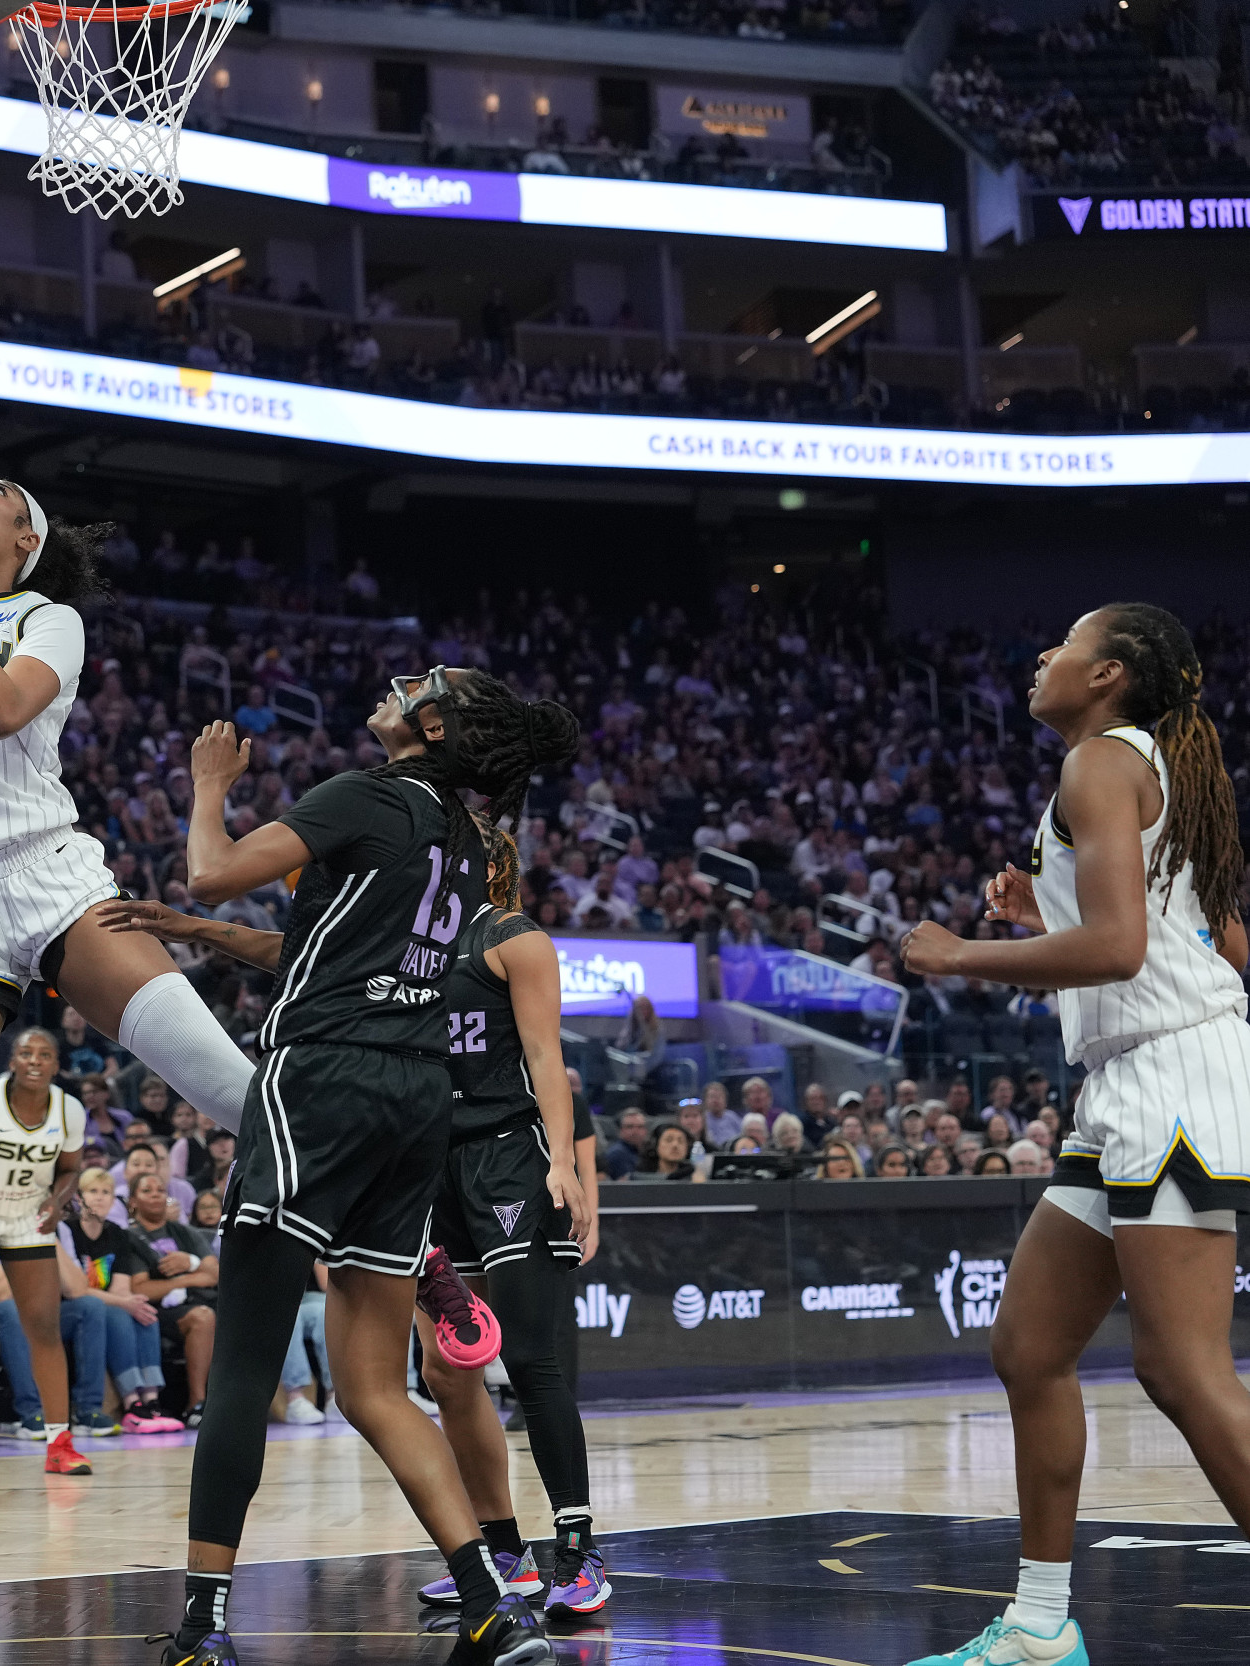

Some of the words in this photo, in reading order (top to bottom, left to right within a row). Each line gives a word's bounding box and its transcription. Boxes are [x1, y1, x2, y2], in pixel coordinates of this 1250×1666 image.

[367, 171, 472, 207] Rakuten
[1101, 200, 1185, 230] GOLDEN
[8, 362, 76, 391] YOUR
[83, 372, 197, 408] FAVORITE
[206, 390, 294, 421] STORES
[648, 434, 714, 457] CASH
[722, 437, 784, 460] BACK
[793, 441, 819, 460] AT
[828, 443, 893, 464] YOUR
[901, 446, 1012, 471] FAVORITE
[1019, 450, 1114, 473] STORES
[559, 952, 645, 995] kuten
[449, 1012, 487, 1054] 22
[5, 1169, 33, 1186] 12
[707, 1289, 766, 1320] AT&T
